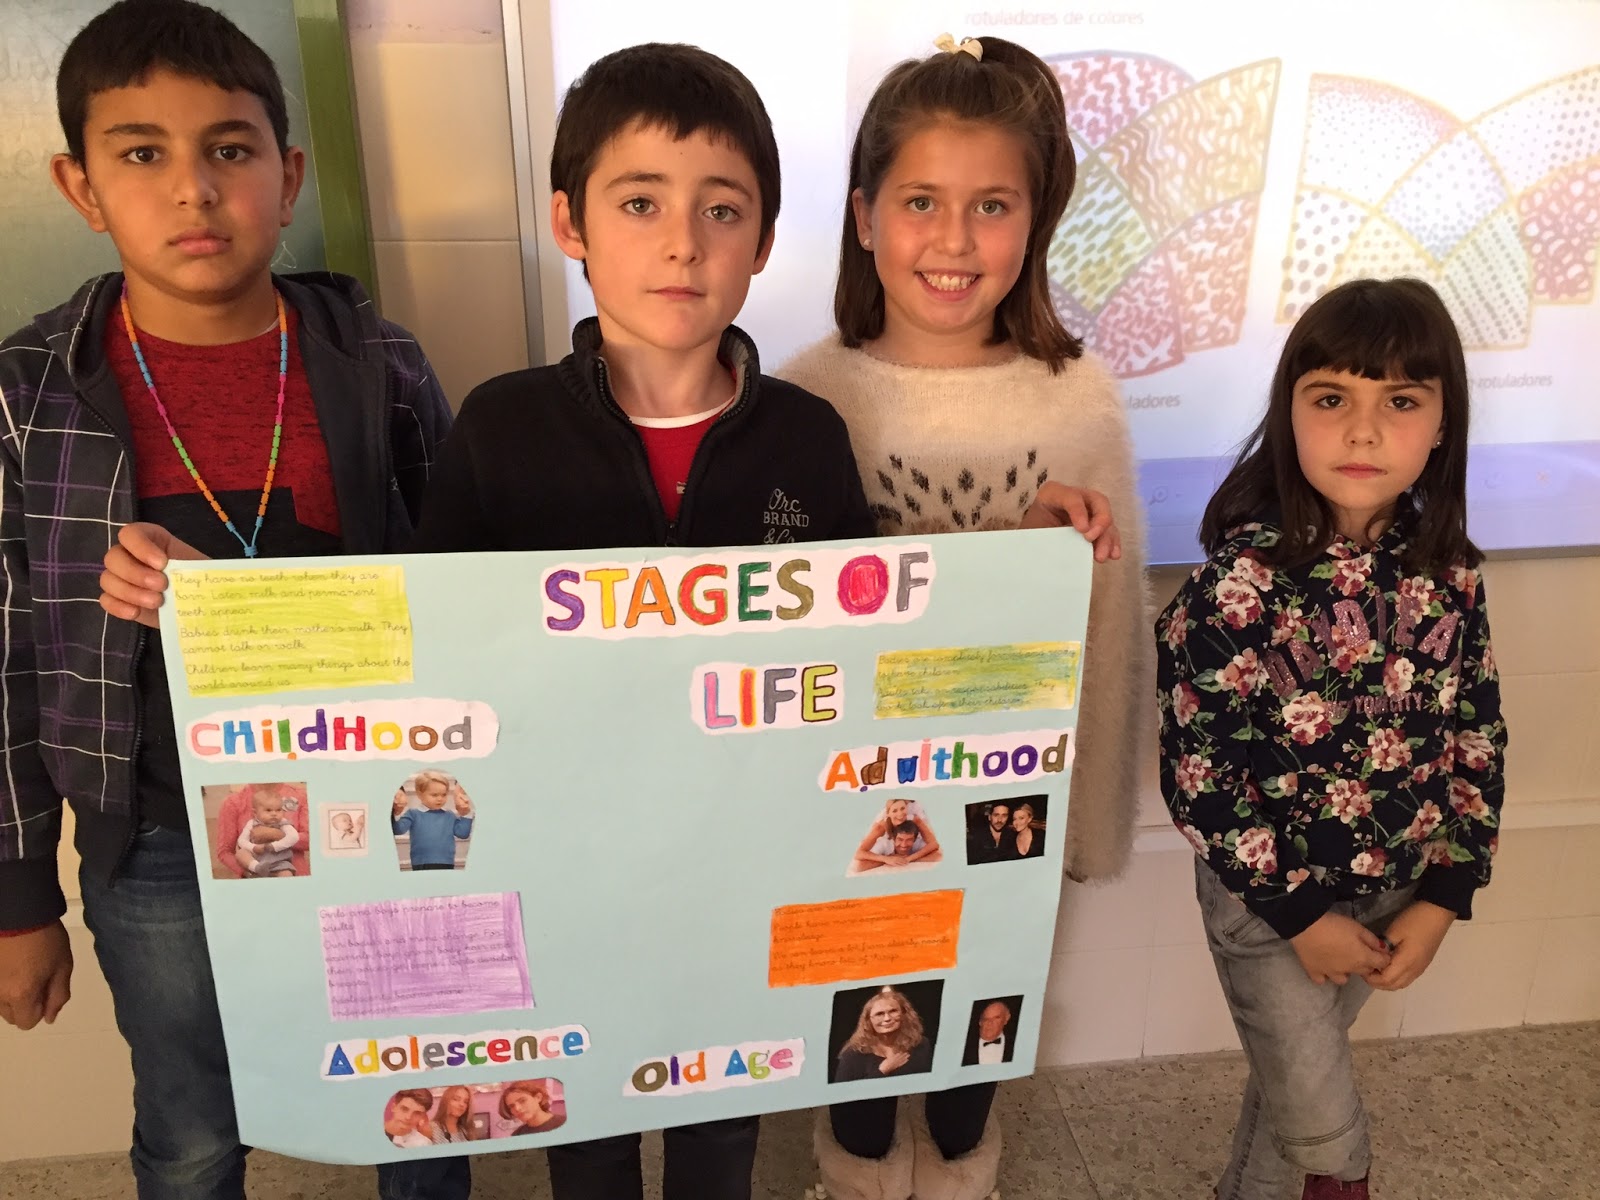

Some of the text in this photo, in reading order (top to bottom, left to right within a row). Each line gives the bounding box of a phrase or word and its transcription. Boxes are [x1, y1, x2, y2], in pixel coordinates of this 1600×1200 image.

[964, 9, 1145, 26] rotuladores de colores
[1477, 371, 1553, 389] rotuladores
[763, 511, 810, 527] BRAND
[173, 572, 202, 588] They
[205, 573, 236, 584] have
[259, 571, 289, 583] teeth
[330, 570, 356, 585] they
[249, 586, 277, 598] milk
[280, 587, 306, 598] and
[308, 588, 377, 601] permanent
[545, 551, 929, 631] STAGES OF
[177, 606, 207, 617] teeth
[180, 627, 220, 639] Babies
[222, 625, 259, 637] drink
[261, 624, 290, 635] their
[182, 644, 227, 654] cannot
[230, 640, 254, 652] talk
[186, 656, 411, 675] Children learn many things about the
[704, 664, 837, 729] LIFE
[325, 1031, 584, 1076] Adolescence
[631, 1047, 793, 1093] Old Age
